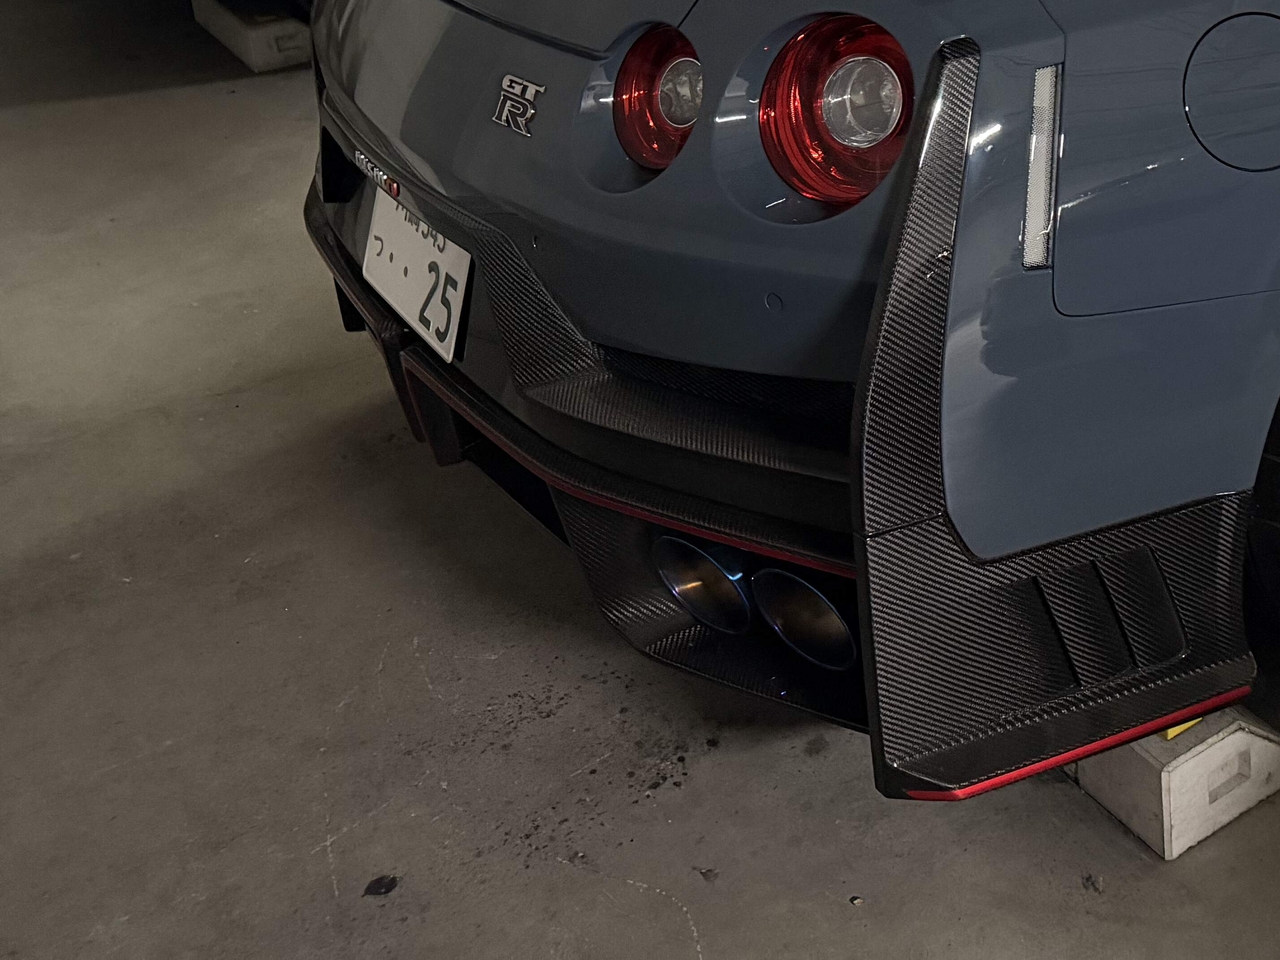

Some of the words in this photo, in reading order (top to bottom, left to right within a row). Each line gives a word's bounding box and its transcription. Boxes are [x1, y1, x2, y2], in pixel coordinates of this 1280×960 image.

[501, 74, 546, 102] GT
[492, 91, 535, 138] R
[418, 260, 459, 344] 25
